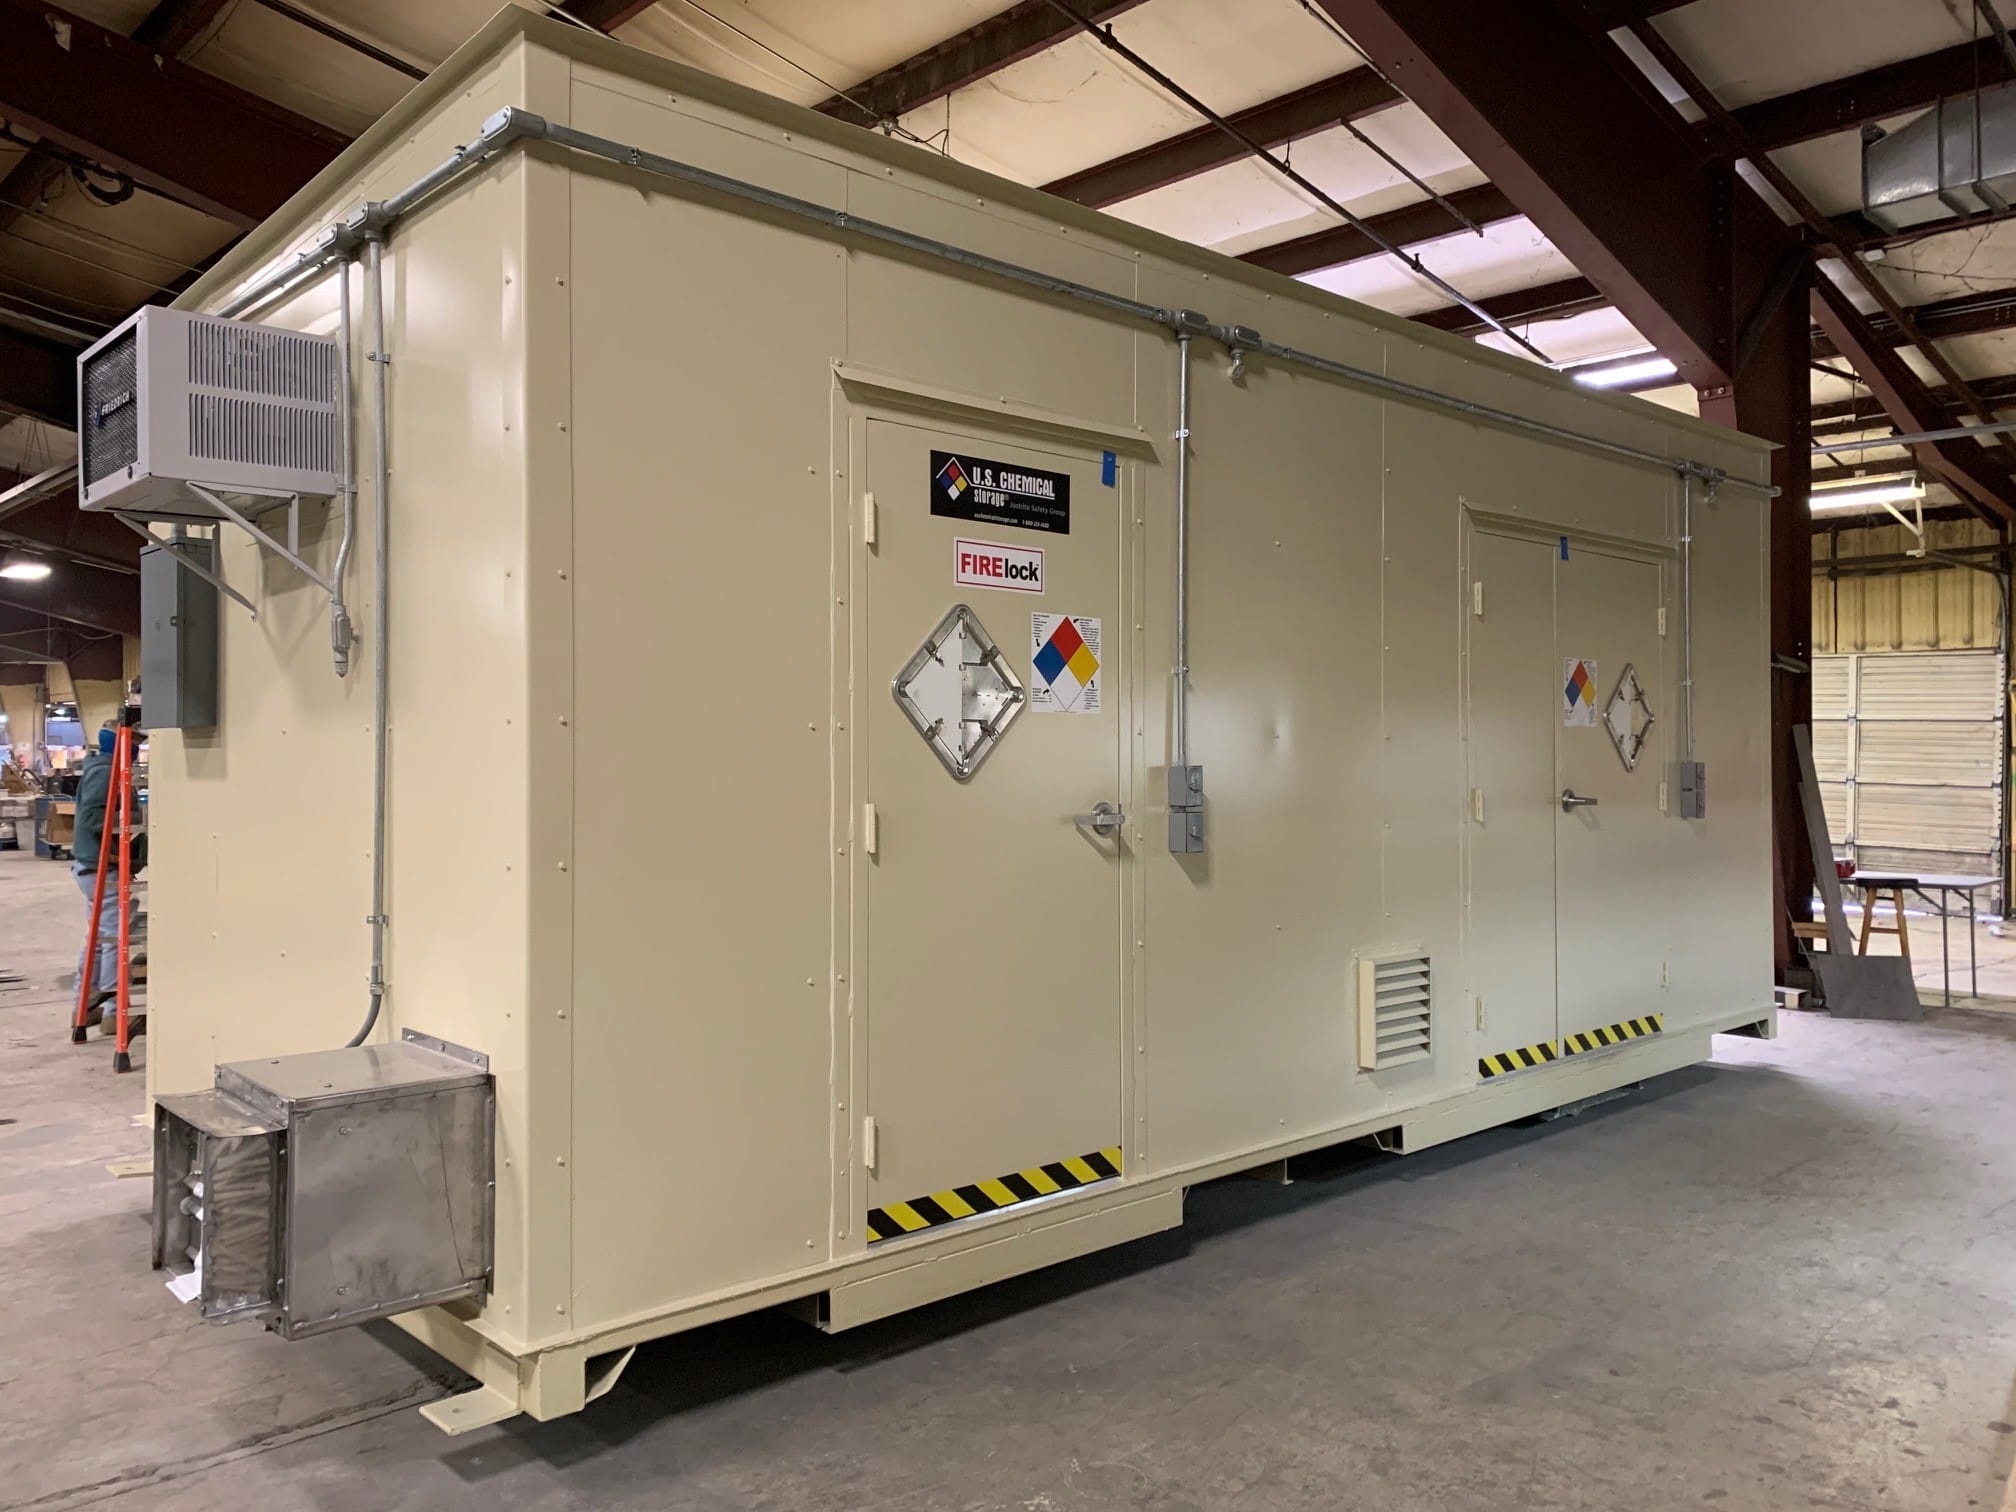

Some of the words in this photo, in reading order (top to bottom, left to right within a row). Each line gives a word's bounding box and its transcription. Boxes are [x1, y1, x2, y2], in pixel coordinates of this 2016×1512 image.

[973, 467, 996, 487] U.S.
[1000, 471, 1055, 497] CHEMICAL
[1031, 504, 1048, 515] Safety
